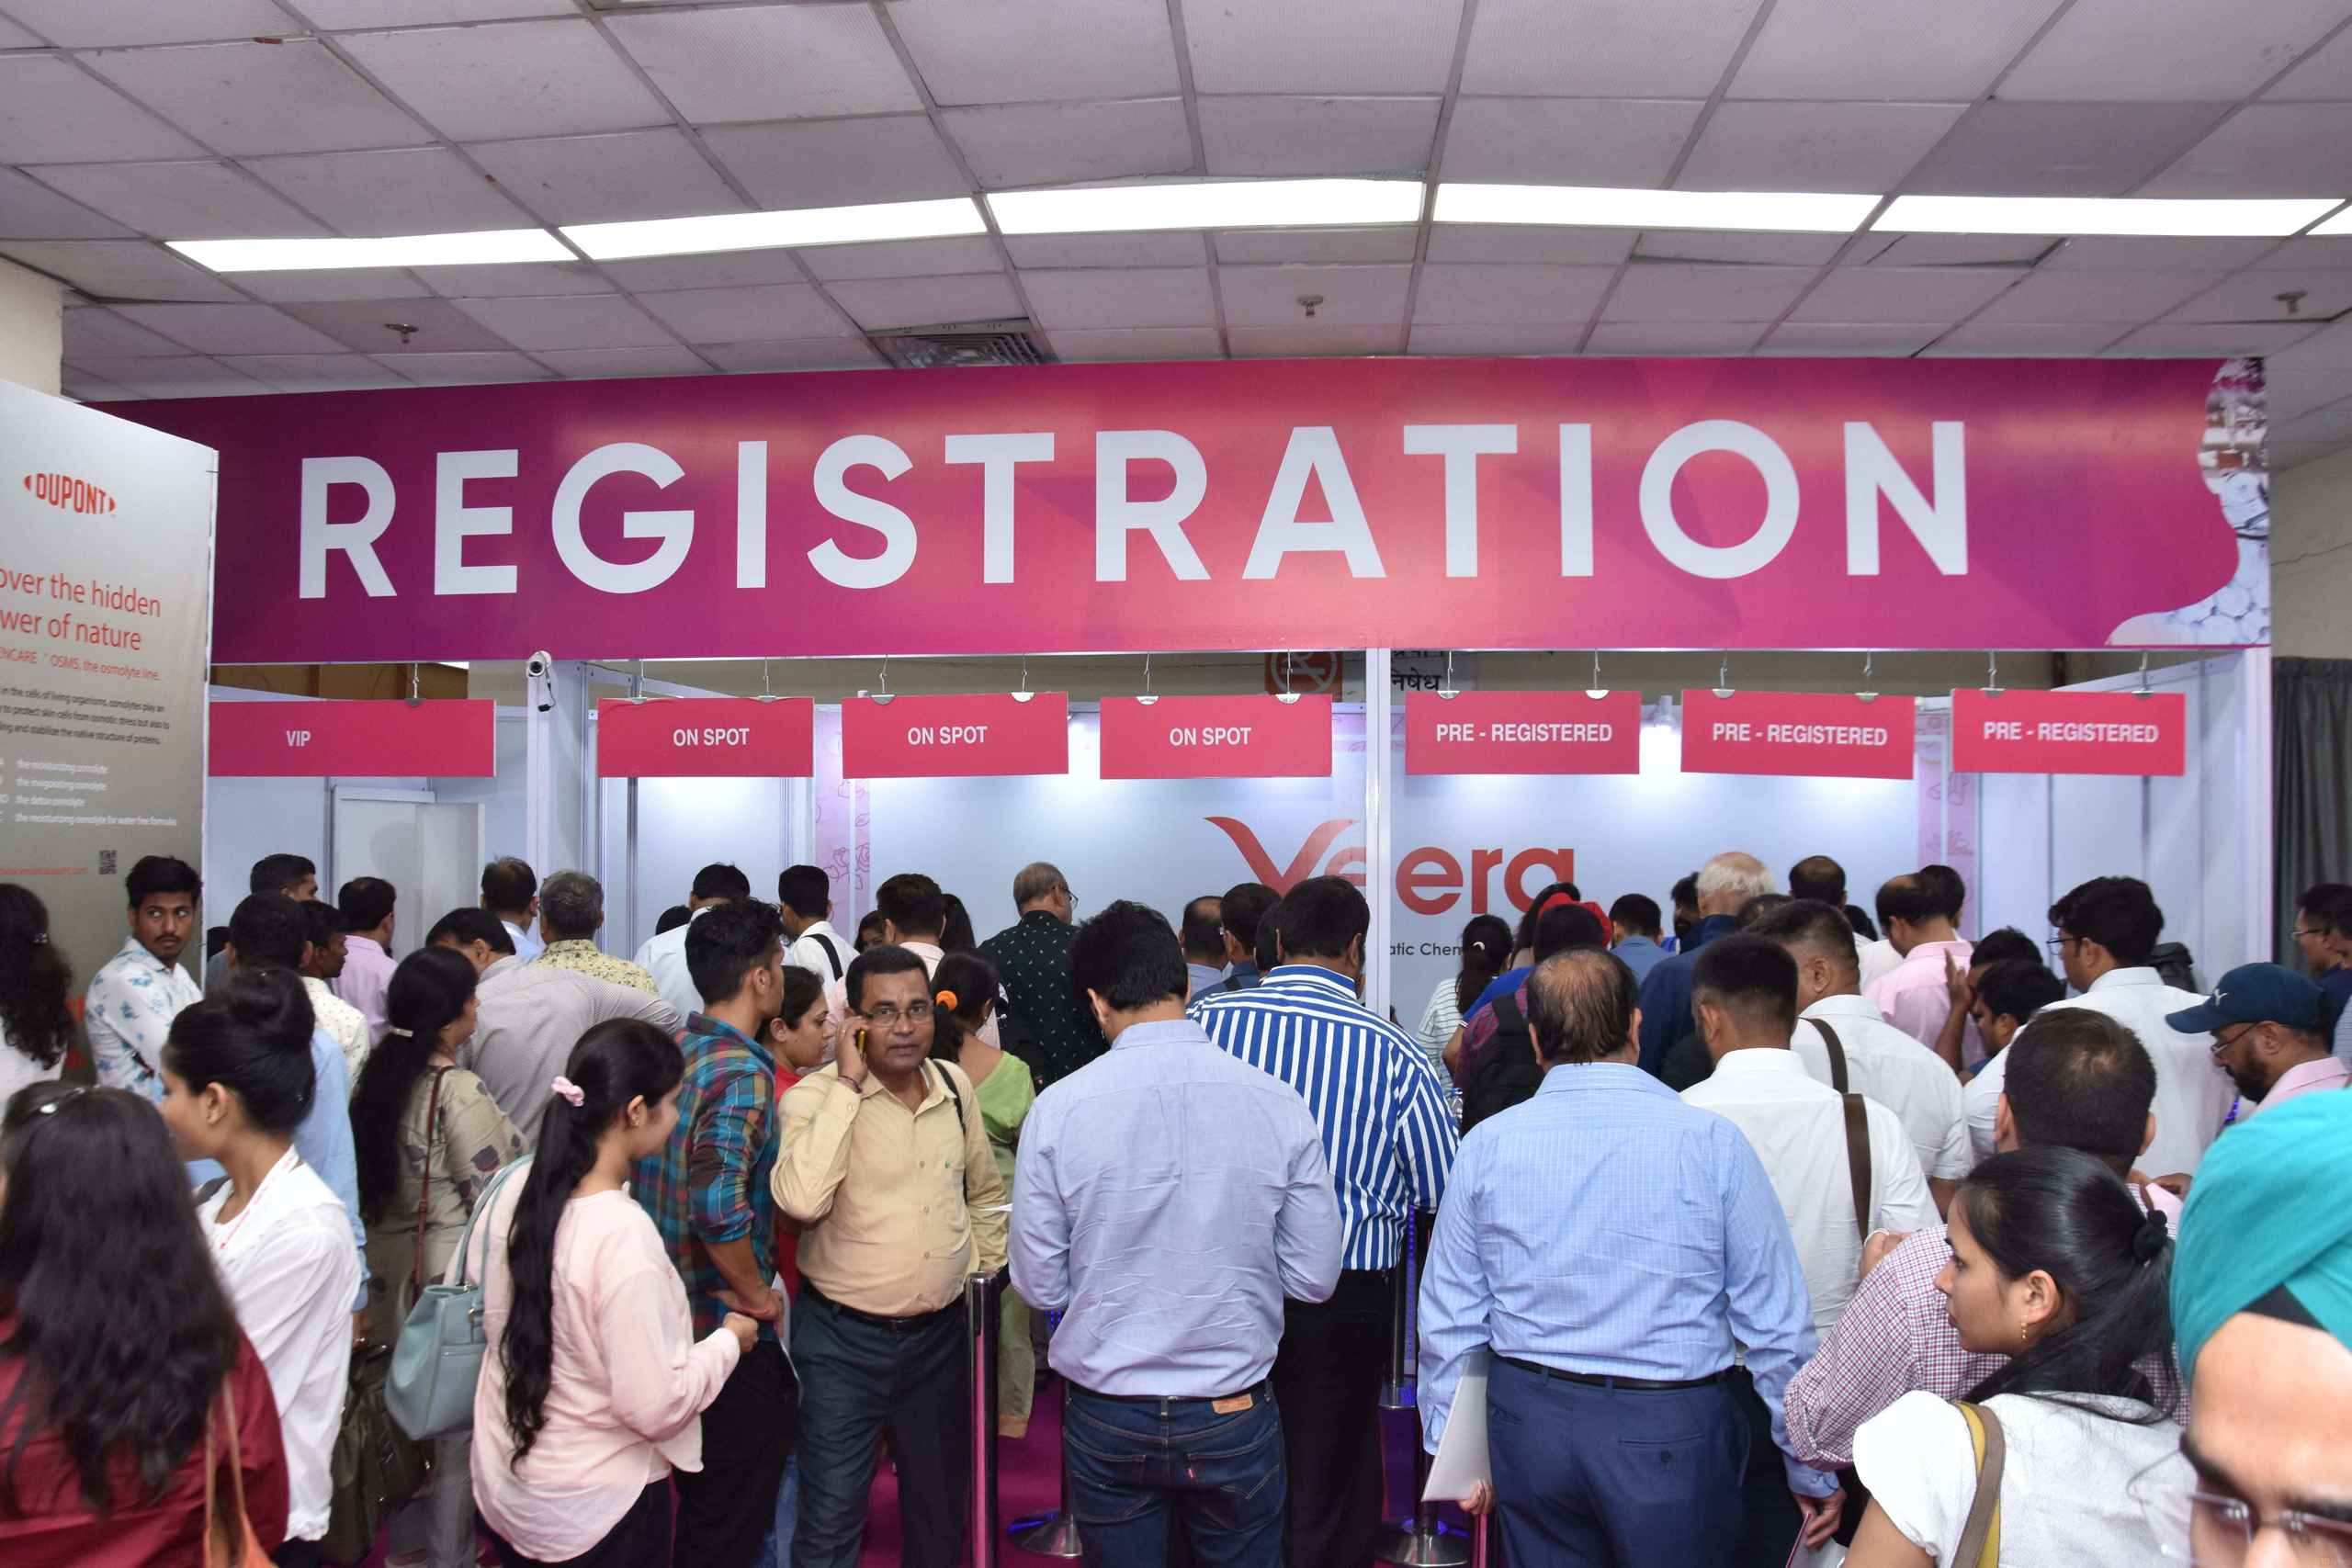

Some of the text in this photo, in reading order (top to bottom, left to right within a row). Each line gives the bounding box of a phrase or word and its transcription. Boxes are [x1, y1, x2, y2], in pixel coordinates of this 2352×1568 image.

[35, 472, 107, 514] DUPONT
[299, 420, 1968, 599] REGISTRATION
[50, 572, 85, 604] the
[92, 580, 162, 618] hidden
[48, 613, 73, 639] of
[75, 622, 141, 651] nature
[286, 730, 311, 747] VIP
[673, 727, 750, 747] ON SPOT
[908, 726, 988, 745] ON SPOT
[1170, 727, 1252, 746] ON SPOT
[1436, 723, 1475, 742] PRE
[1491, 723, 1612, 742] REGISTERED
[1713, 723, 1750, 741] PRE
[1767, 724, 1887, 746] REGISTERED
[1984, 721, 2022, 741] PRE
[2038, 722, 2158, 743] REGISTERED
